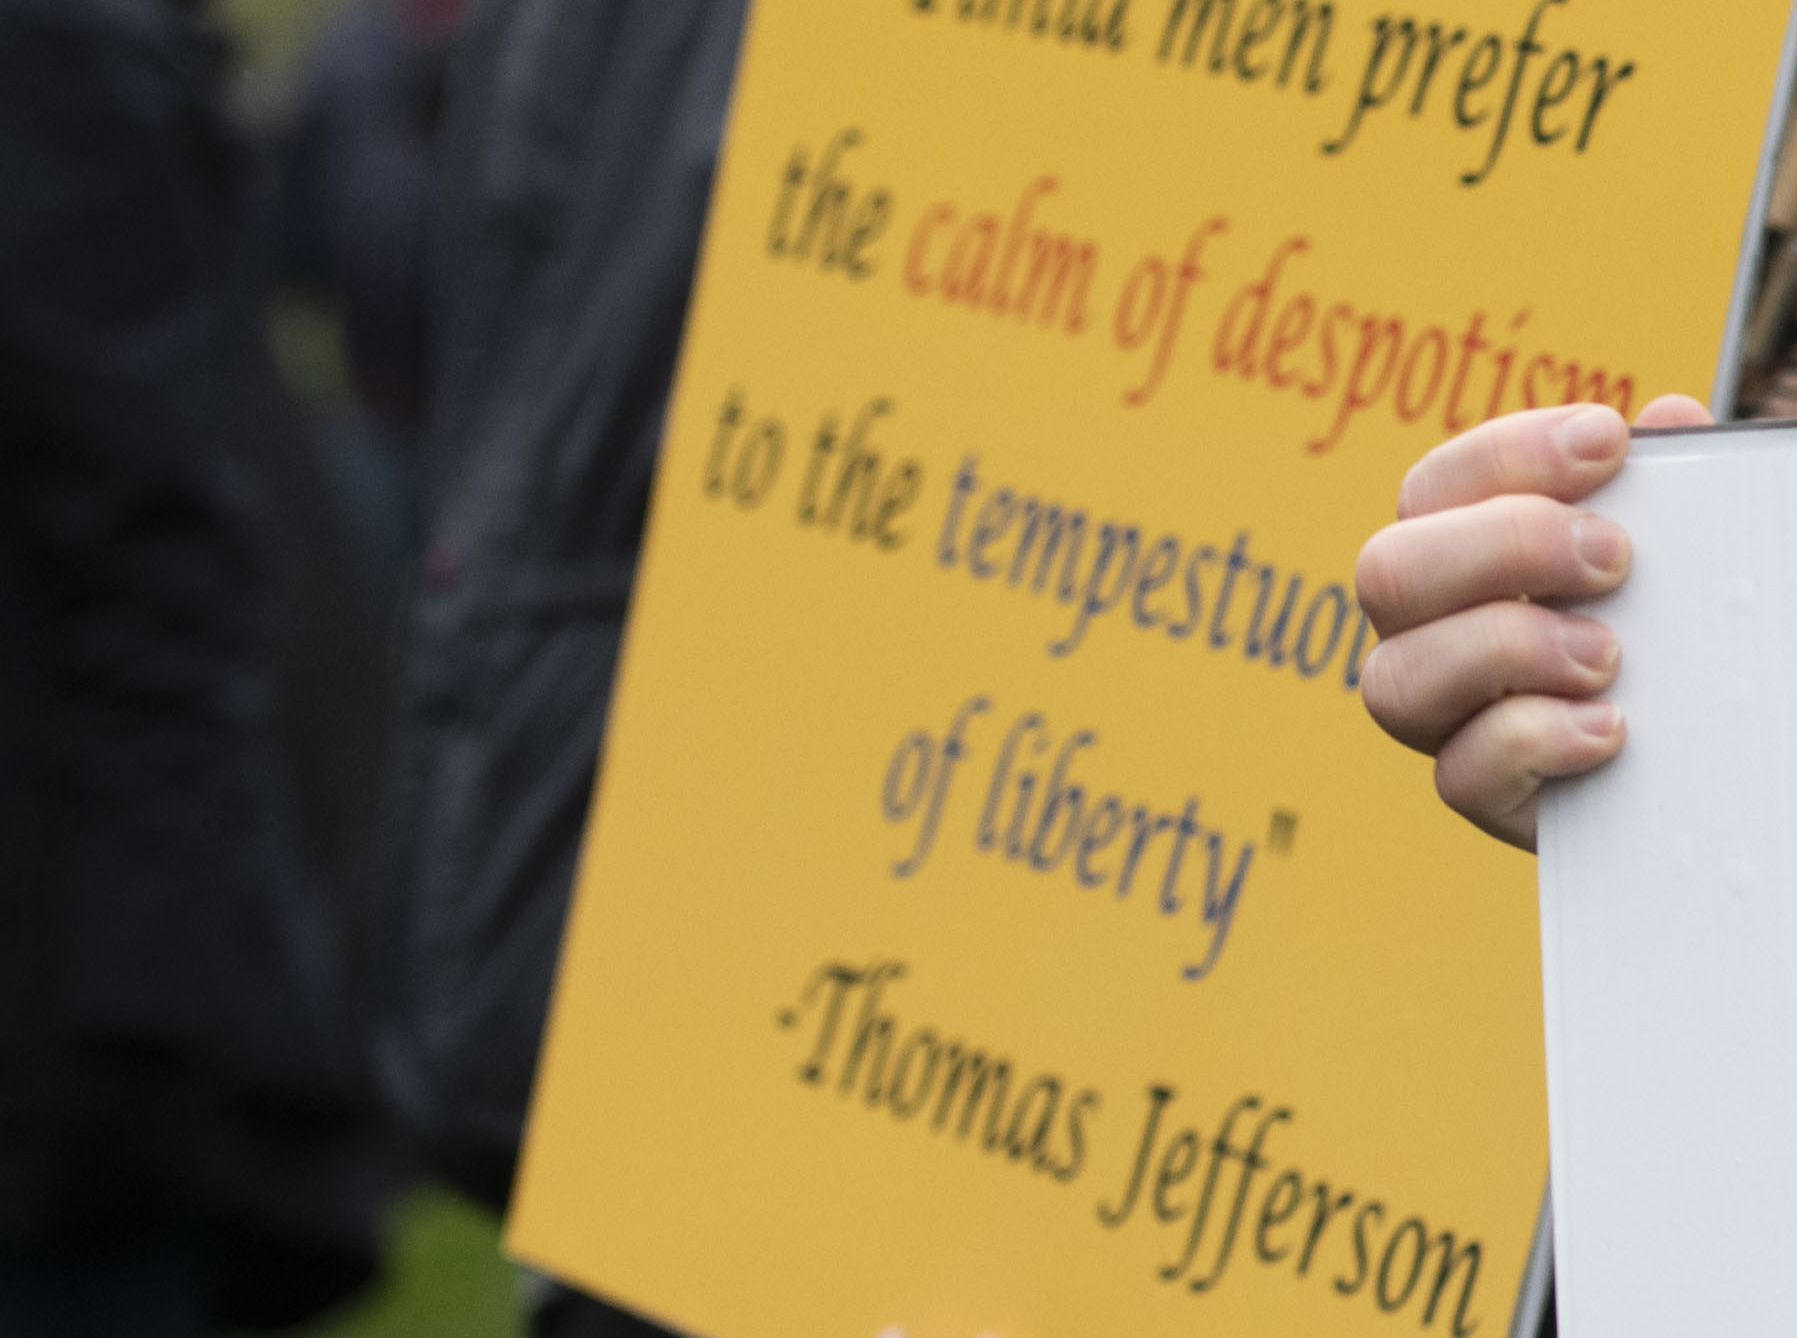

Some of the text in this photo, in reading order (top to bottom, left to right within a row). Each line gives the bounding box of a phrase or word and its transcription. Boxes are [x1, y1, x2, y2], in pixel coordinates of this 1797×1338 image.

[767, 127, 896, 282] the
[904, 173, 1100, 336] calm
[1112, 214, 1231, 409] of
[704, 384, 788, 512] to
[795, 395, 923, 553] the
[882, 695, 1299, 983] of liberty"
[776, 958, 1101, 1183] -Thomas
